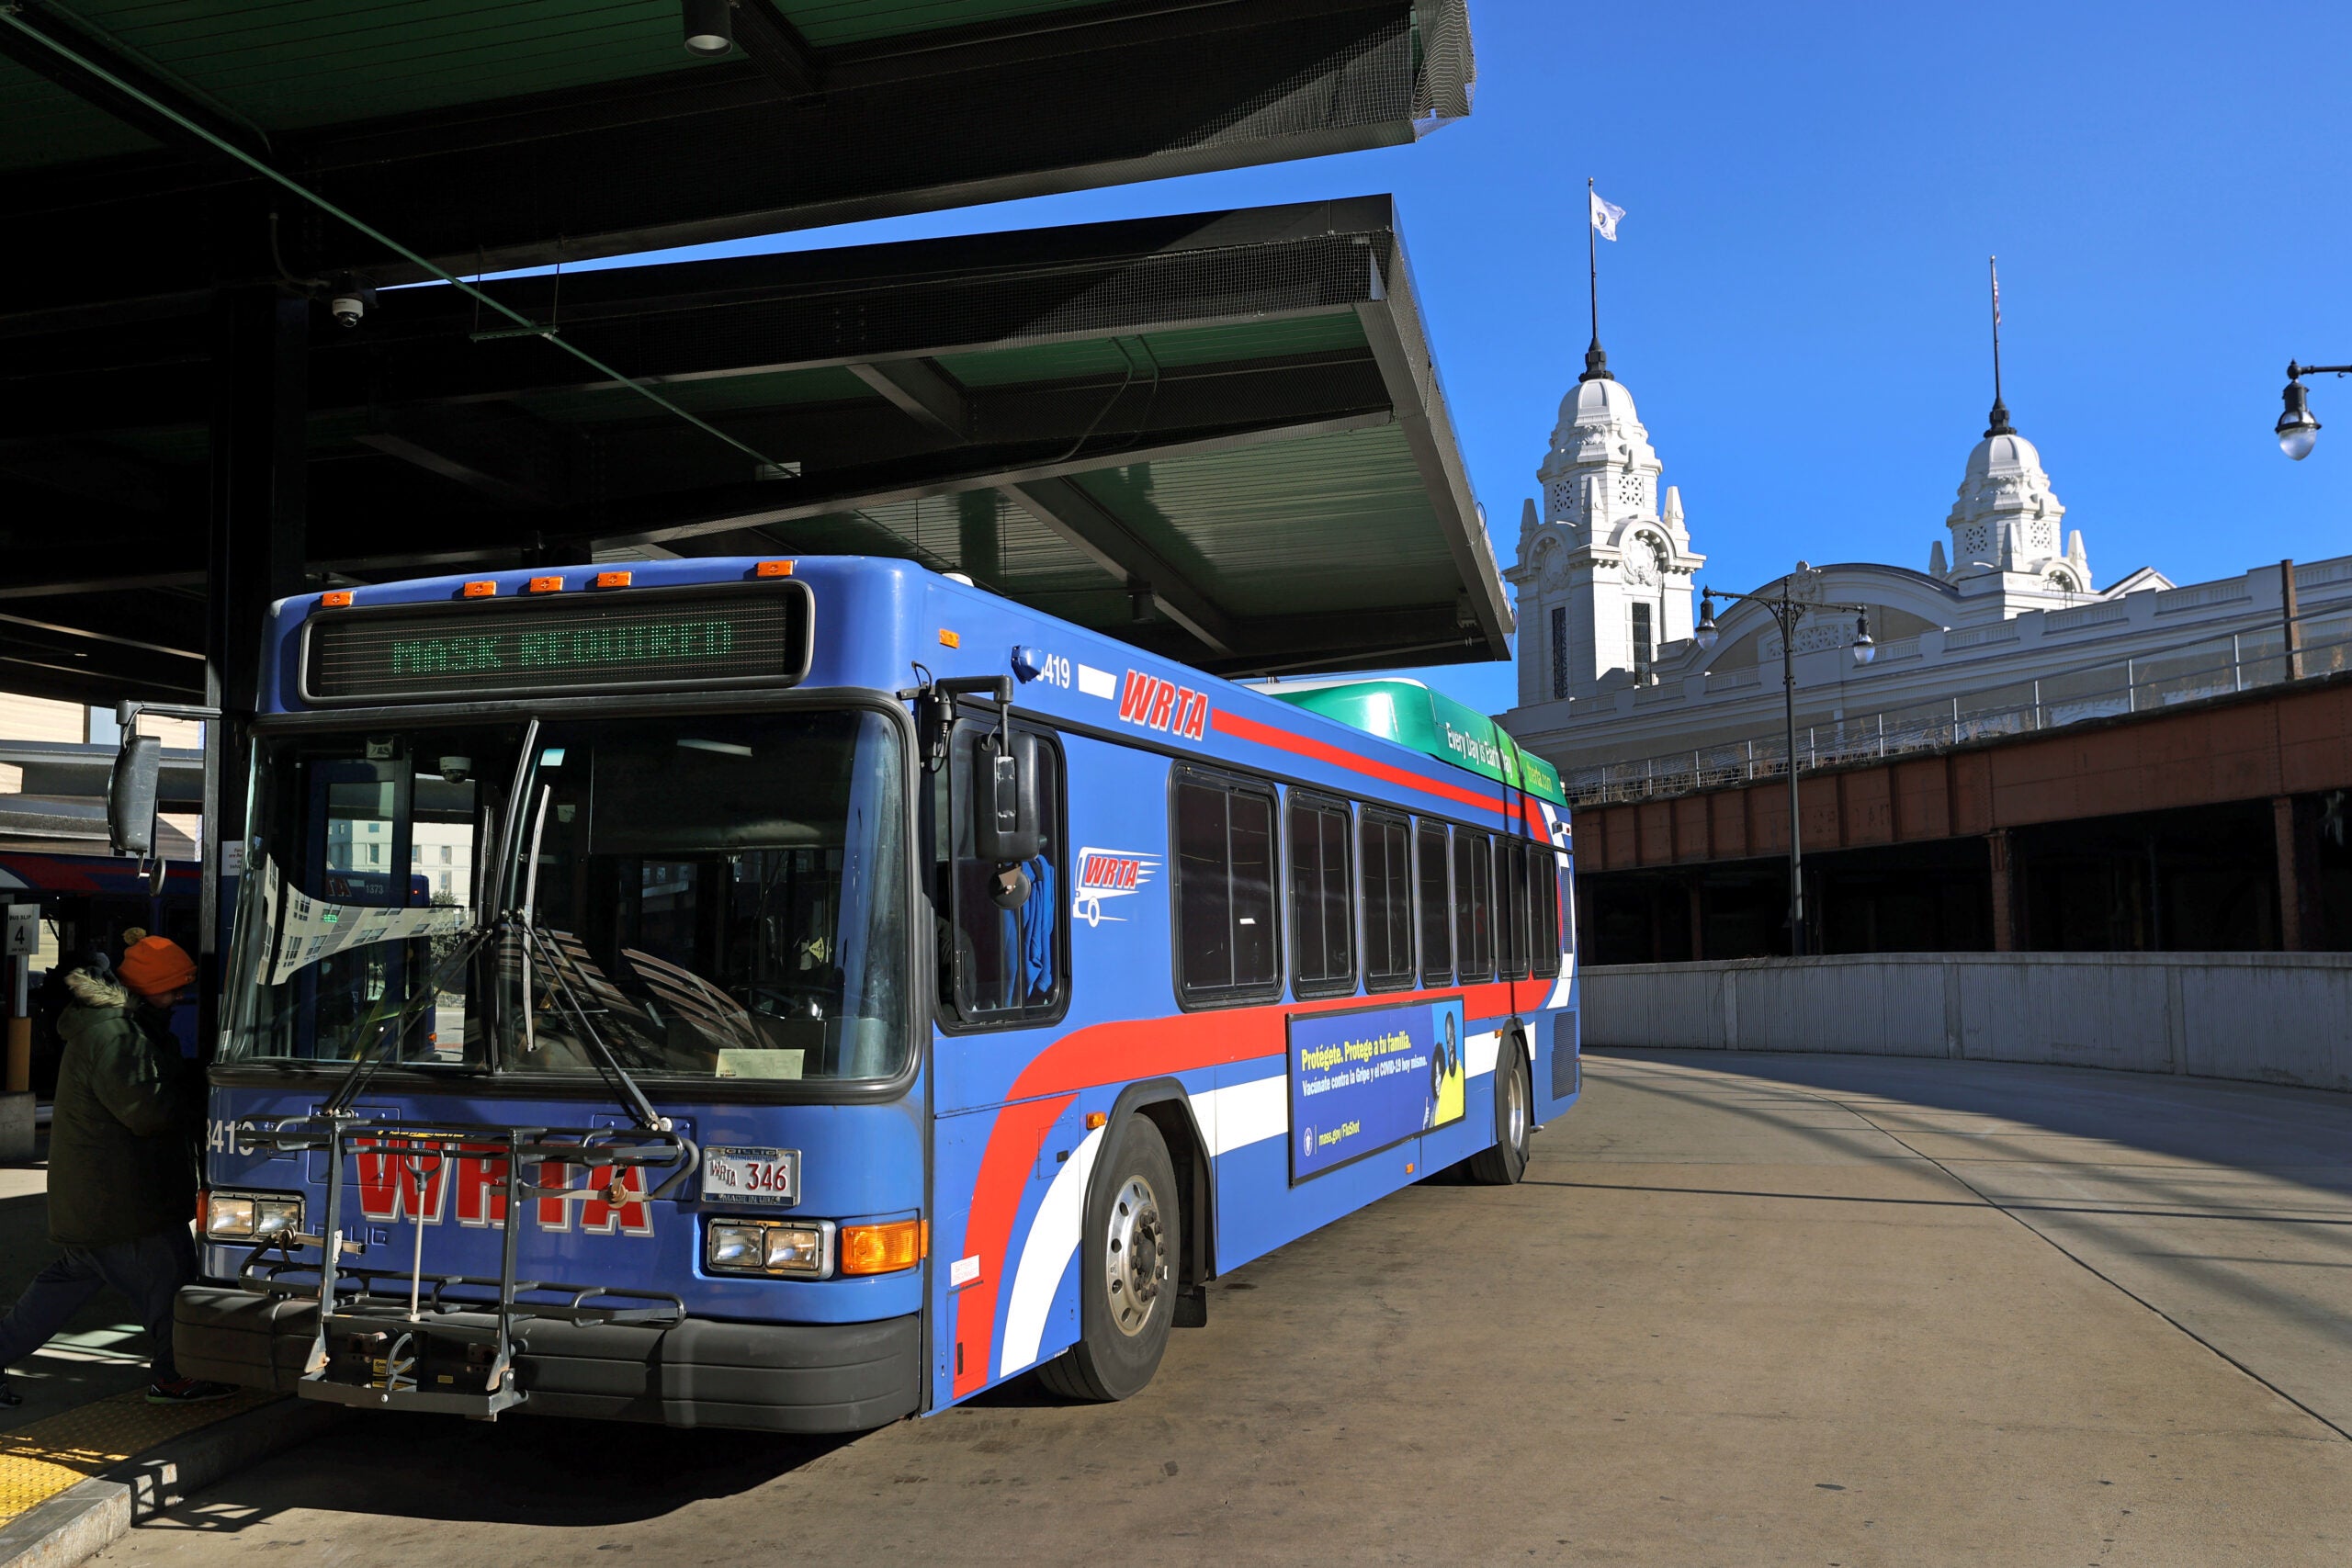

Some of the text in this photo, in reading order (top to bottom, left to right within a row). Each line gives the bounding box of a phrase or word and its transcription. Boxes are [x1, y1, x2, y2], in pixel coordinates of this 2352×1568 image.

[393, 621, 731, 673] MASK REQUIRED
[1036, 653, 1070, 689] 419
[1119, 669, 1208, 742] WRTA
[1445, 721, 1466, 760] Every
[1464, 731, 1479, 765] Day
[1484, 740, 1501, 770] Earth
[366, 884, 384, 895] 1373
[1085, 855, 1140, 890] WRTA
[15, 925, 25, 945] 4
[1301, 1030, 1411, 1072] Protégete. Protege a tu familia.
[1302, 1054, 1428, 1097] Vacúnate contra la Gripe y el COVID-19 hoy mismo.
[355, 1136, 655, 1237] WRTA
[710, 1159, 787, 1191] WRTA 346
